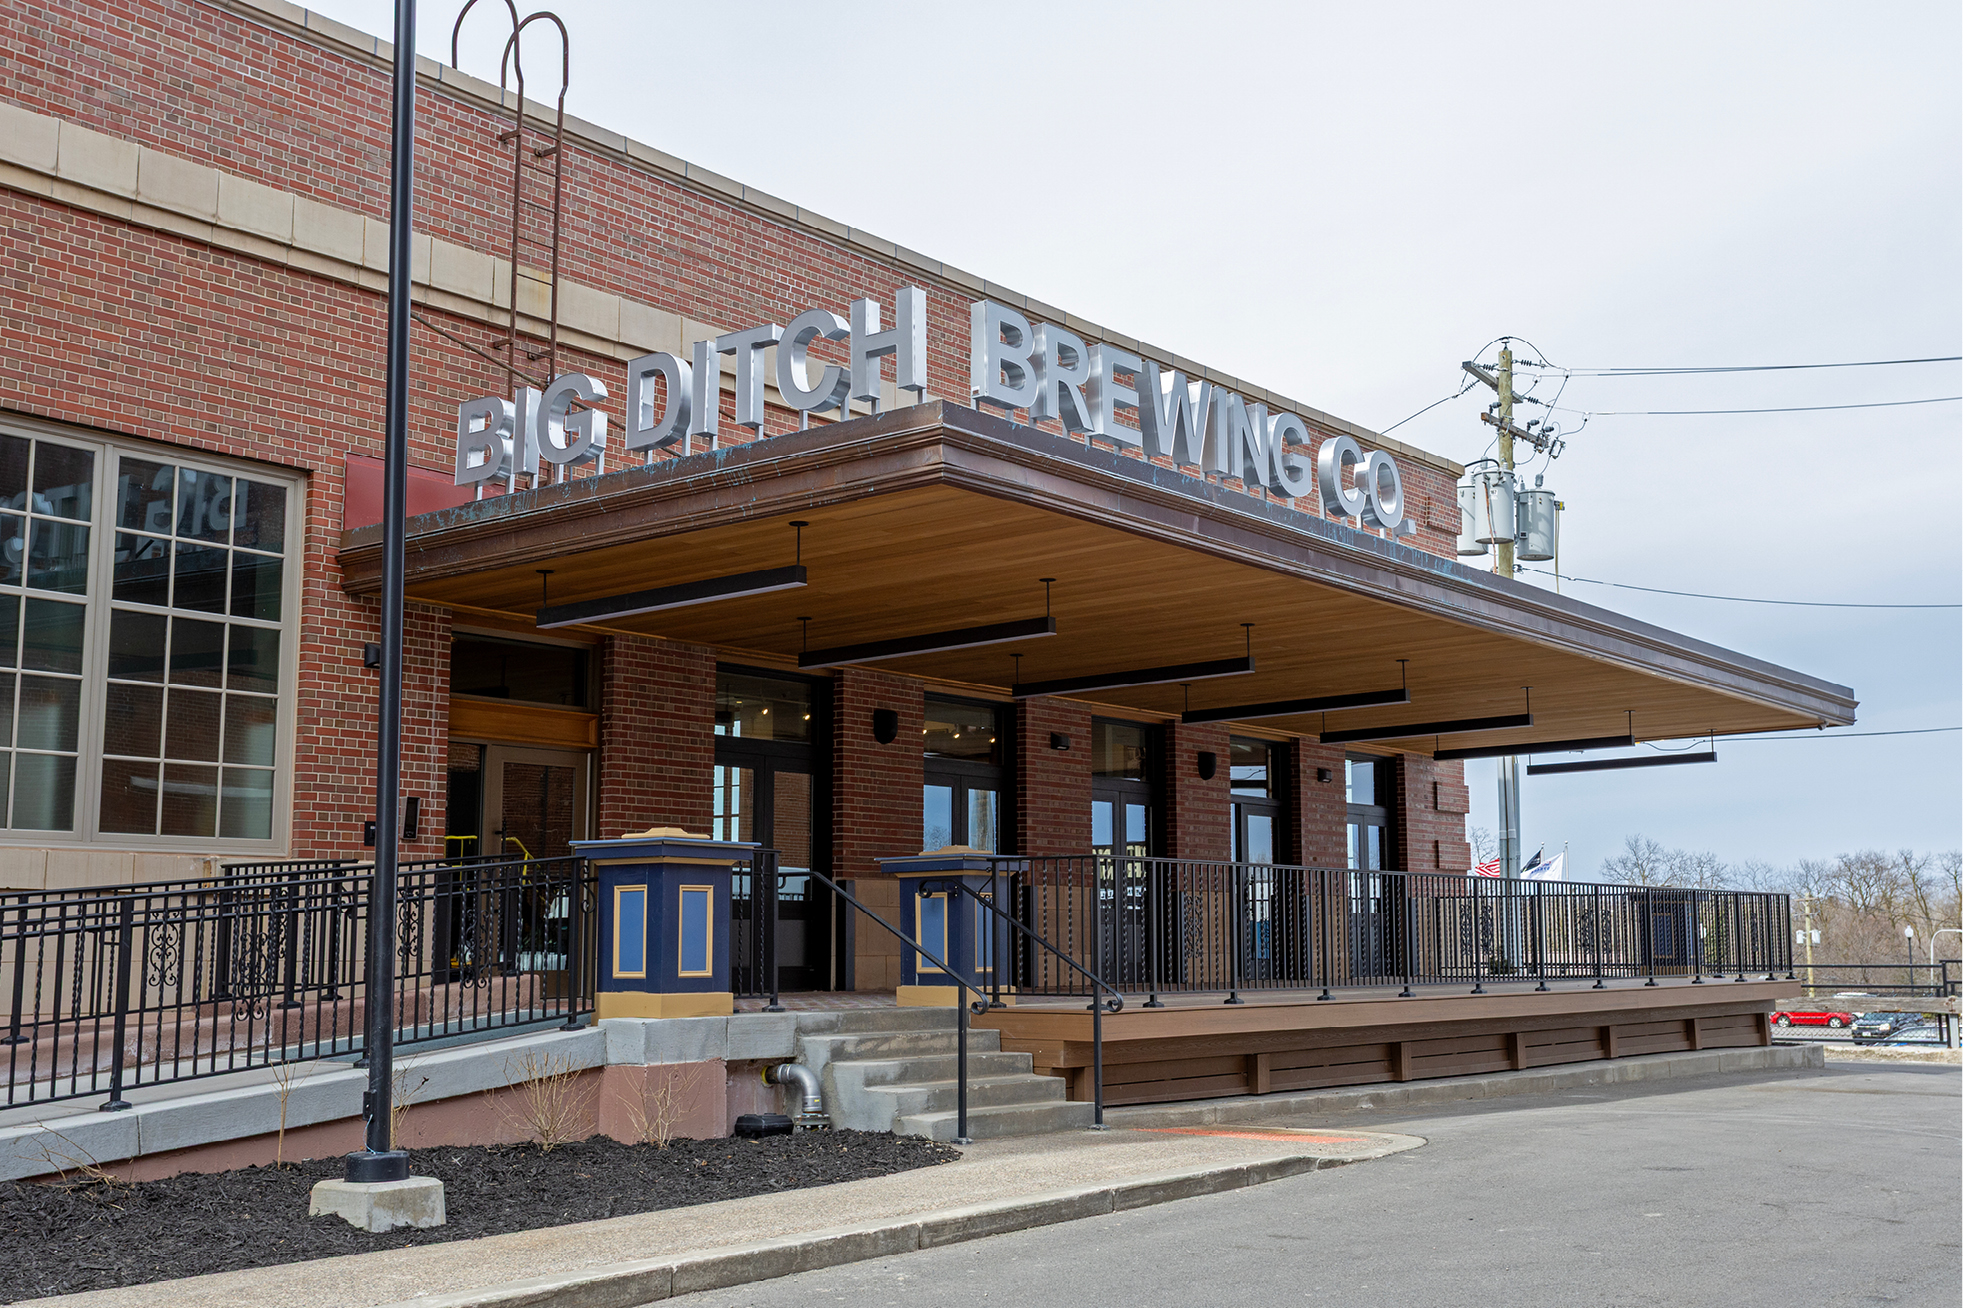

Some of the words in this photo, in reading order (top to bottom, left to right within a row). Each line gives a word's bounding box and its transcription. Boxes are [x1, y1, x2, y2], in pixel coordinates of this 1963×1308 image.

[455, 372, 608, 486] BIG
[624, 285, 927, 452] DITCH
[971, 299, 1312, 498] BREWING
[1318, 435, 1416, 537] CO.
